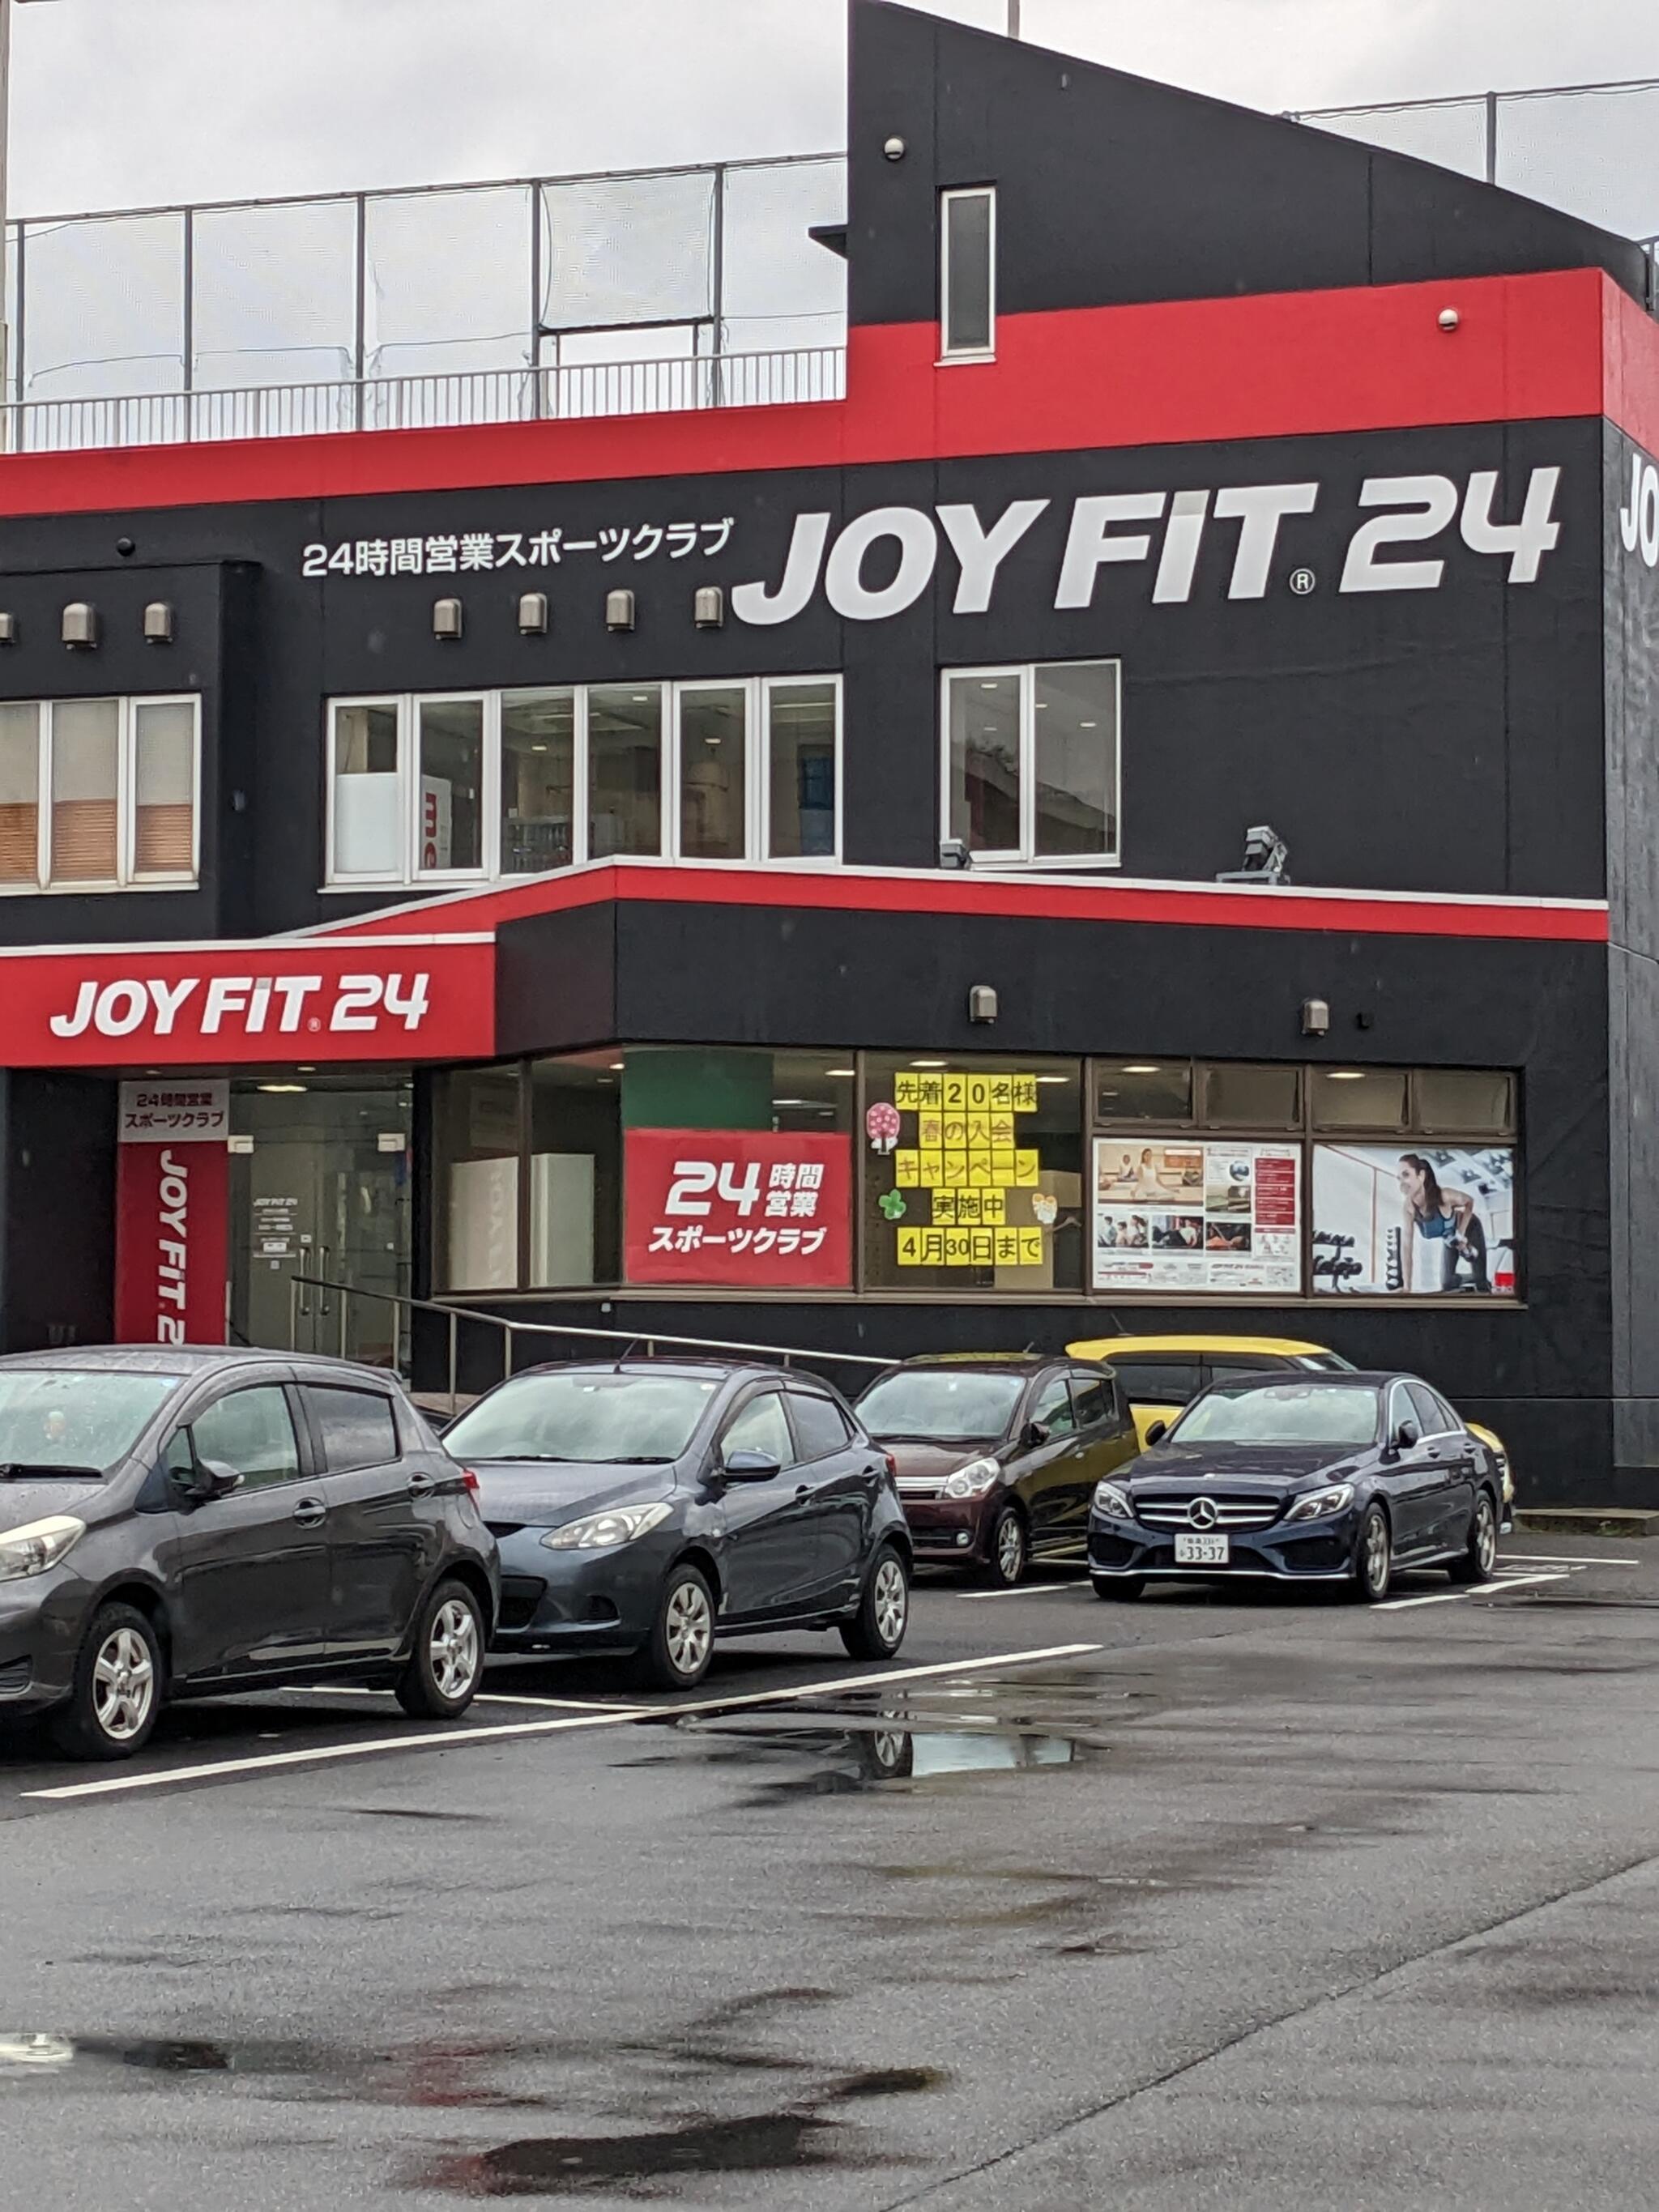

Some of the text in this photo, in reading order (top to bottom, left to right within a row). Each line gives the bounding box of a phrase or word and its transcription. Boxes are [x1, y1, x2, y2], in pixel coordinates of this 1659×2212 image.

[302, 517, 735, 577] 24時間営業スポーツクラブ
[731, 498, 1051, 625] JOY
[1054, 483, 1319, 609] FIT
[1338, 466, 1561, 593] 24
[49, 973, 429, 1038] JOY FIT 24
[896, 1080, 1036, 1106] 先着20名様
[126, 1110, 224, 1128] スポーツクラブ
[922, 1119, 1012, 1143] 春の入会
[769, 1162, 825, 1190] 時間
[898, 1157, 1035, 1180] キャンペーン
[160, 1149, 187, 1238] JOY
[664, 1161, 761, 1216] 24
[765, 1191, 819, 1217] 営業
[933, 1195, 1003, 1219] 実施中
[648, 1225, 827, 1255] スポーツクラブ
[902, 1234, 1040, 1262] 4月30日まで
